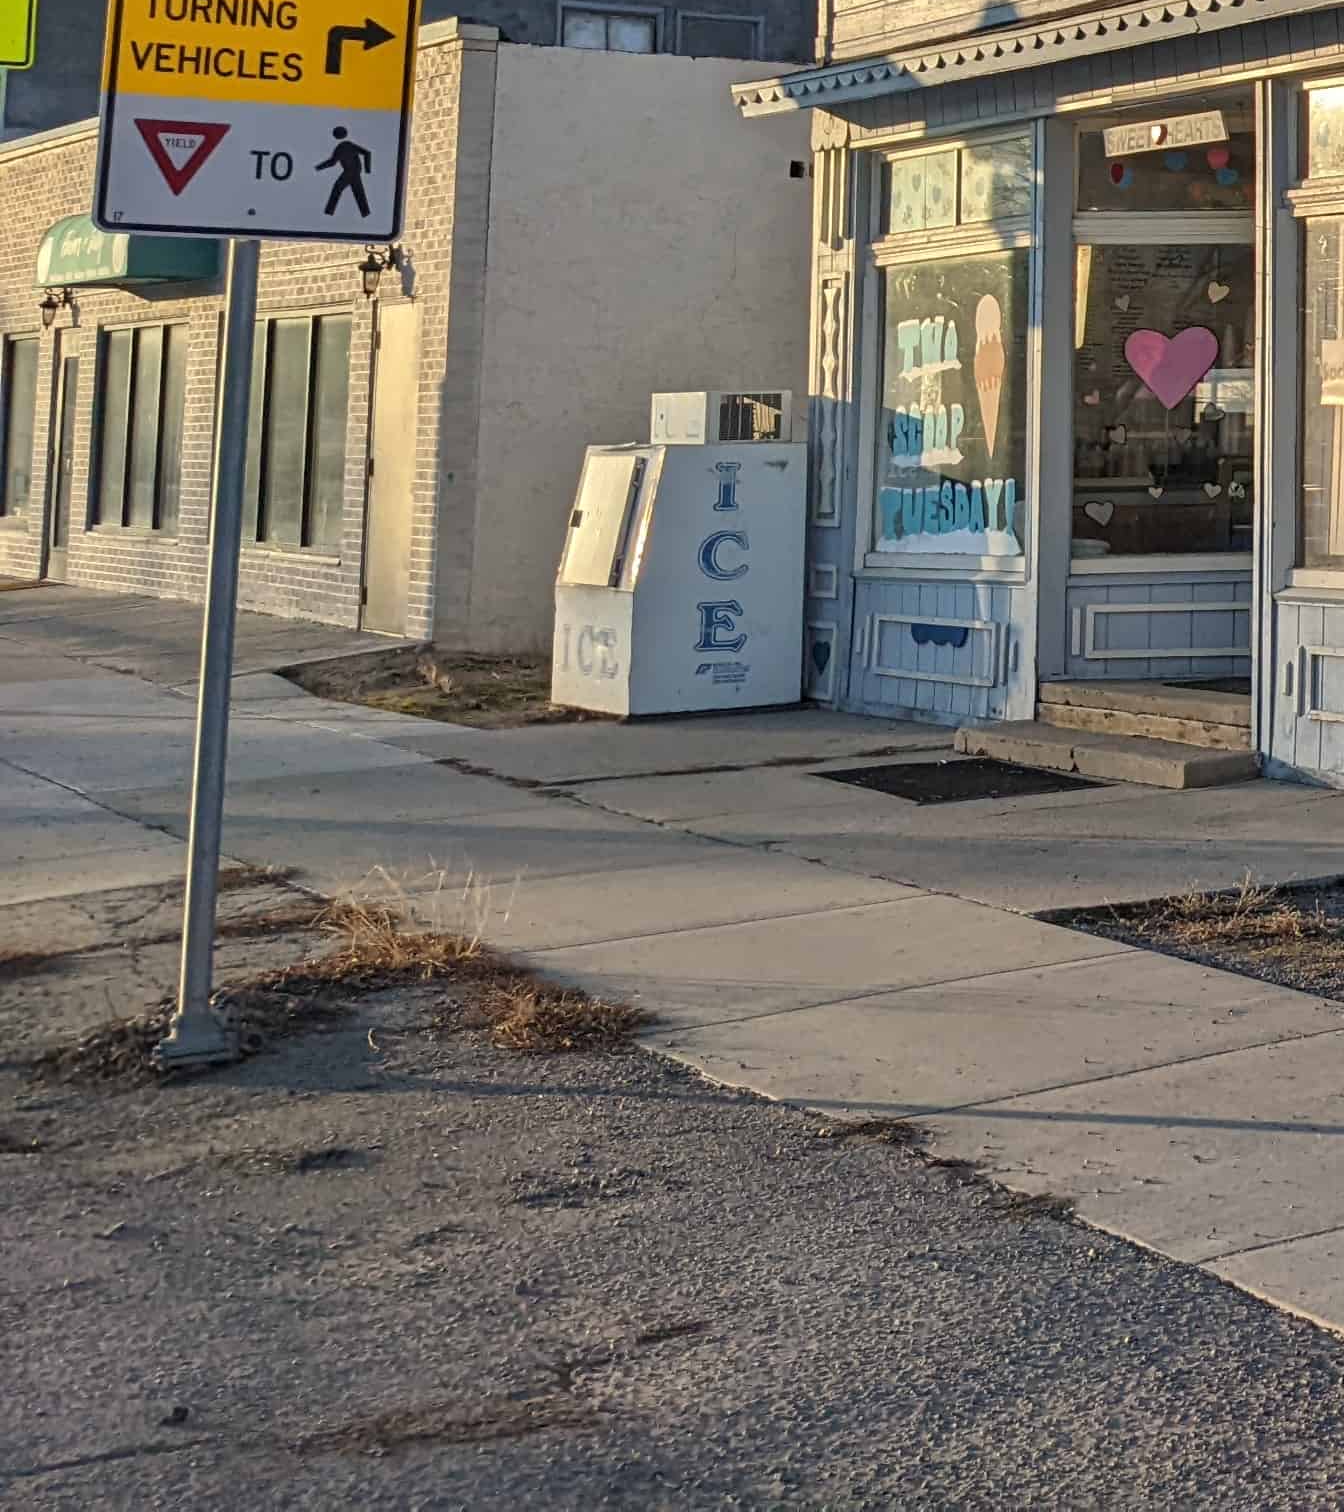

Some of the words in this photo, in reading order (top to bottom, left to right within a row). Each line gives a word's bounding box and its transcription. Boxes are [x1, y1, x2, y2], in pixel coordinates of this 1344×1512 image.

[131, 41, 304, 83] VEHICLES
[164, 136, 198, 150] YIELD
[250, 150, 294, 182] TO
[879, 477, 1016, 541] TUESDAY!
